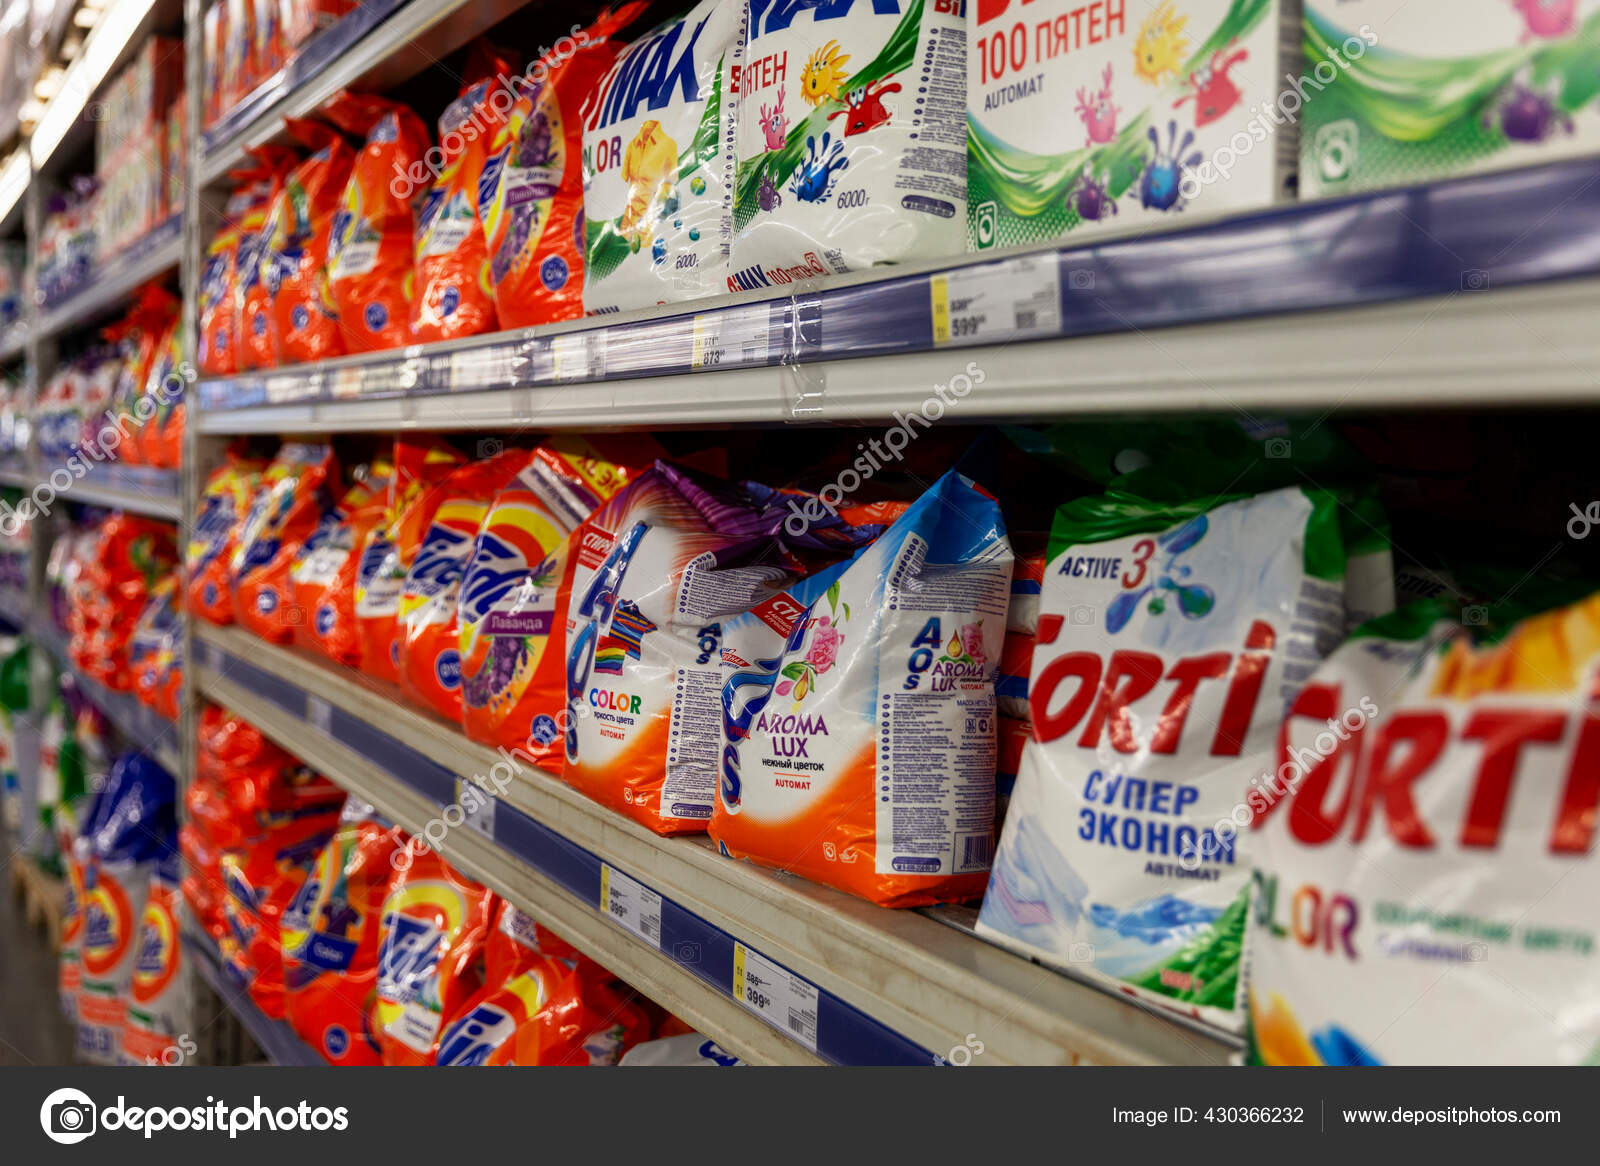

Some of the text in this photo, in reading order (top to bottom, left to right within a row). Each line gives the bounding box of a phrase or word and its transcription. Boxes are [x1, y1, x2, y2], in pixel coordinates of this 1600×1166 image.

[977, 21, 1027, 85] 100
[1035, 0, 1125, 64] ПЯТЕН
[984, 74, 1045, 112] AUTOMAT
[1058, 539, 1156, 589] ACTIVE 3
[491, 614, 543, 632] Лаванда
[931, 661, 985, 678] AROMA
[589, 688, 642, 715] COLOR
[618, 714, 635, 727] цвета
[756, 711, 829, 736] AROMA
[599, 729, 625, 741] AUTOMAT
[772, 736, 809, 758] LUX
[762, 758, 824, 772] нежный цветок
[775, 778, 811, 790] AUTOMAT
[1083, 770, 1199, 816] СУПЕР
[1078, 808, 1239, 865] ЭКОНОМ
[1144, 861, 1222, 881] АВТОМАТ
[746, 986, 766, 1009] 399
